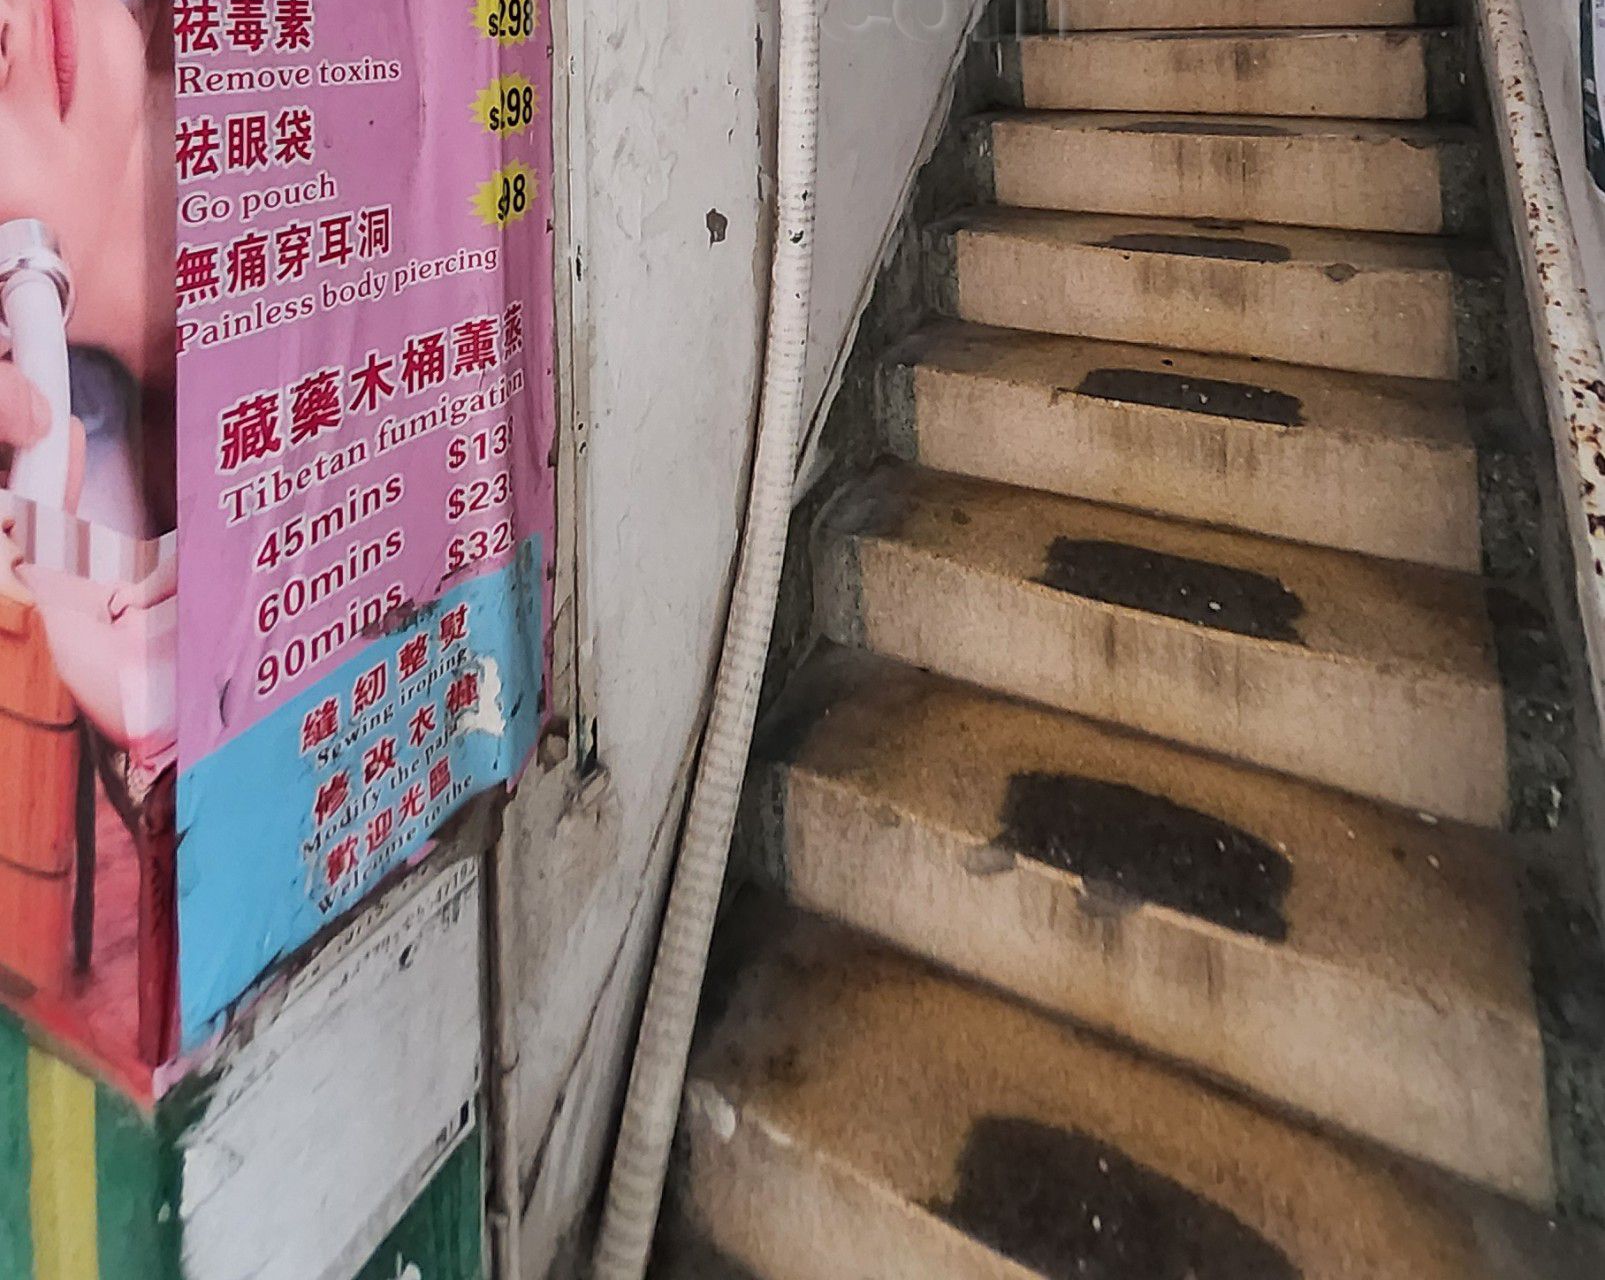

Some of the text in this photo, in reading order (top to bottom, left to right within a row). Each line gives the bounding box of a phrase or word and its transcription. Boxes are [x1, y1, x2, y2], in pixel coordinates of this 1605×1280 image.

[178, 57, 400, 95] Remove toxins
[181, 172, 336, 224] Go pouch
[175, 208, 391, 308] 無痛穿耳洞
[176, 247, 498, 353] Painless body piercing
[223, 369, 524, 523] Tibetan fumigation
[256, 476, 402, 570] 45mins
[258, 530, 403, 634] 60mins
[257, 582, 403, 697] 90mins
